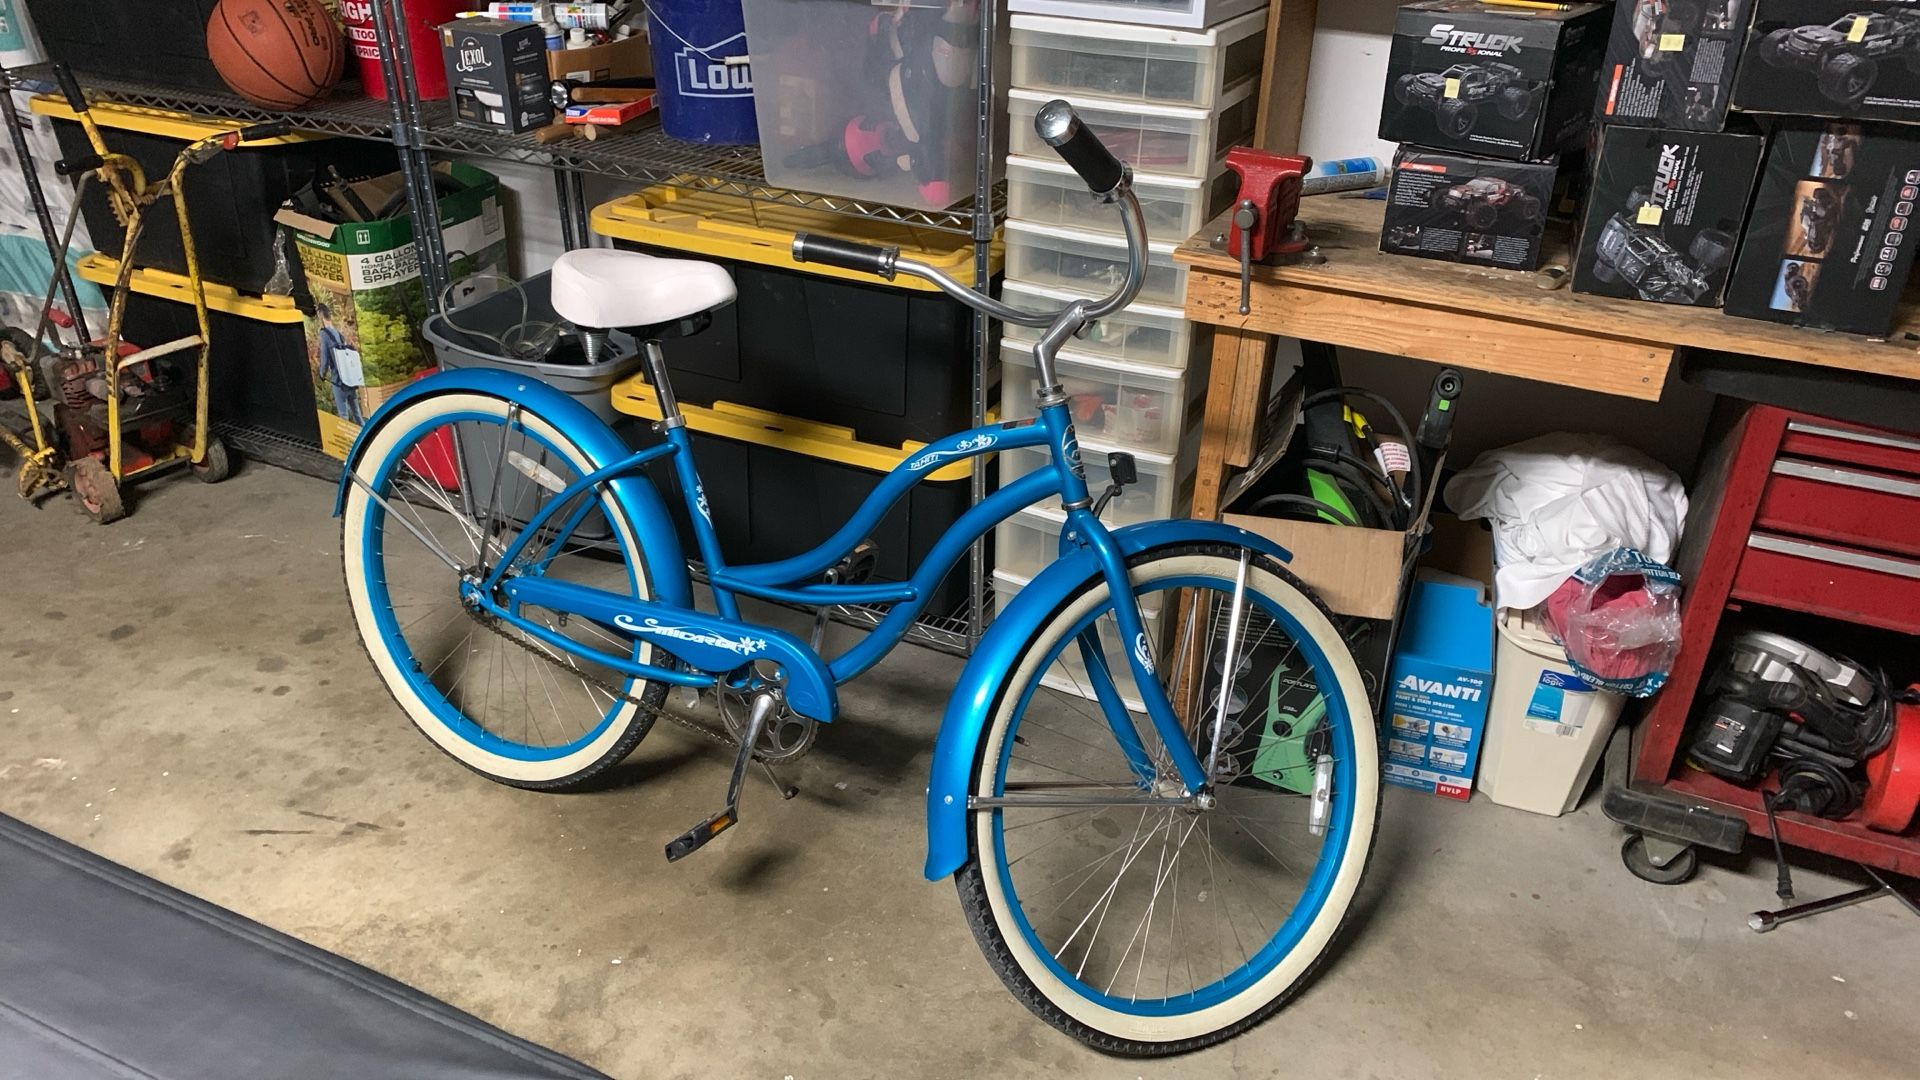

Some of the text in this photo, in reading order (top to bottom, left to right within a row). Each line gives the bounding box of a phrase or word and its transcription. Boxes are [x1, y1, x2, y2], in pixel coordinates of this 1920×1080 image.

[341, 1, 374, 22] IGH
[355, 29, 375, 40] TOO
[1422, 24, 1524, 54] STRUCK
[357, 46, 380, 57] PRIC
[456, 46, 492, 71] LEXOL
[688, 58, 753, 90] Low
[1645, 144, 1680, 209] TRUCK
[360, 244, 417, 265] 4 GALLON
[304, 264, 345, 283] PRAYER
[363, 264, 420, 284] SPRAYER
[910, 454, 939, 470] TAHITI
[1282, 678, 1317, 690] PORTLAND
[1397, 675, 1482, 702] AVANTI
[1542, 677, 1565, 688] logic
[1440, 786, 1462, 795] HVLP
